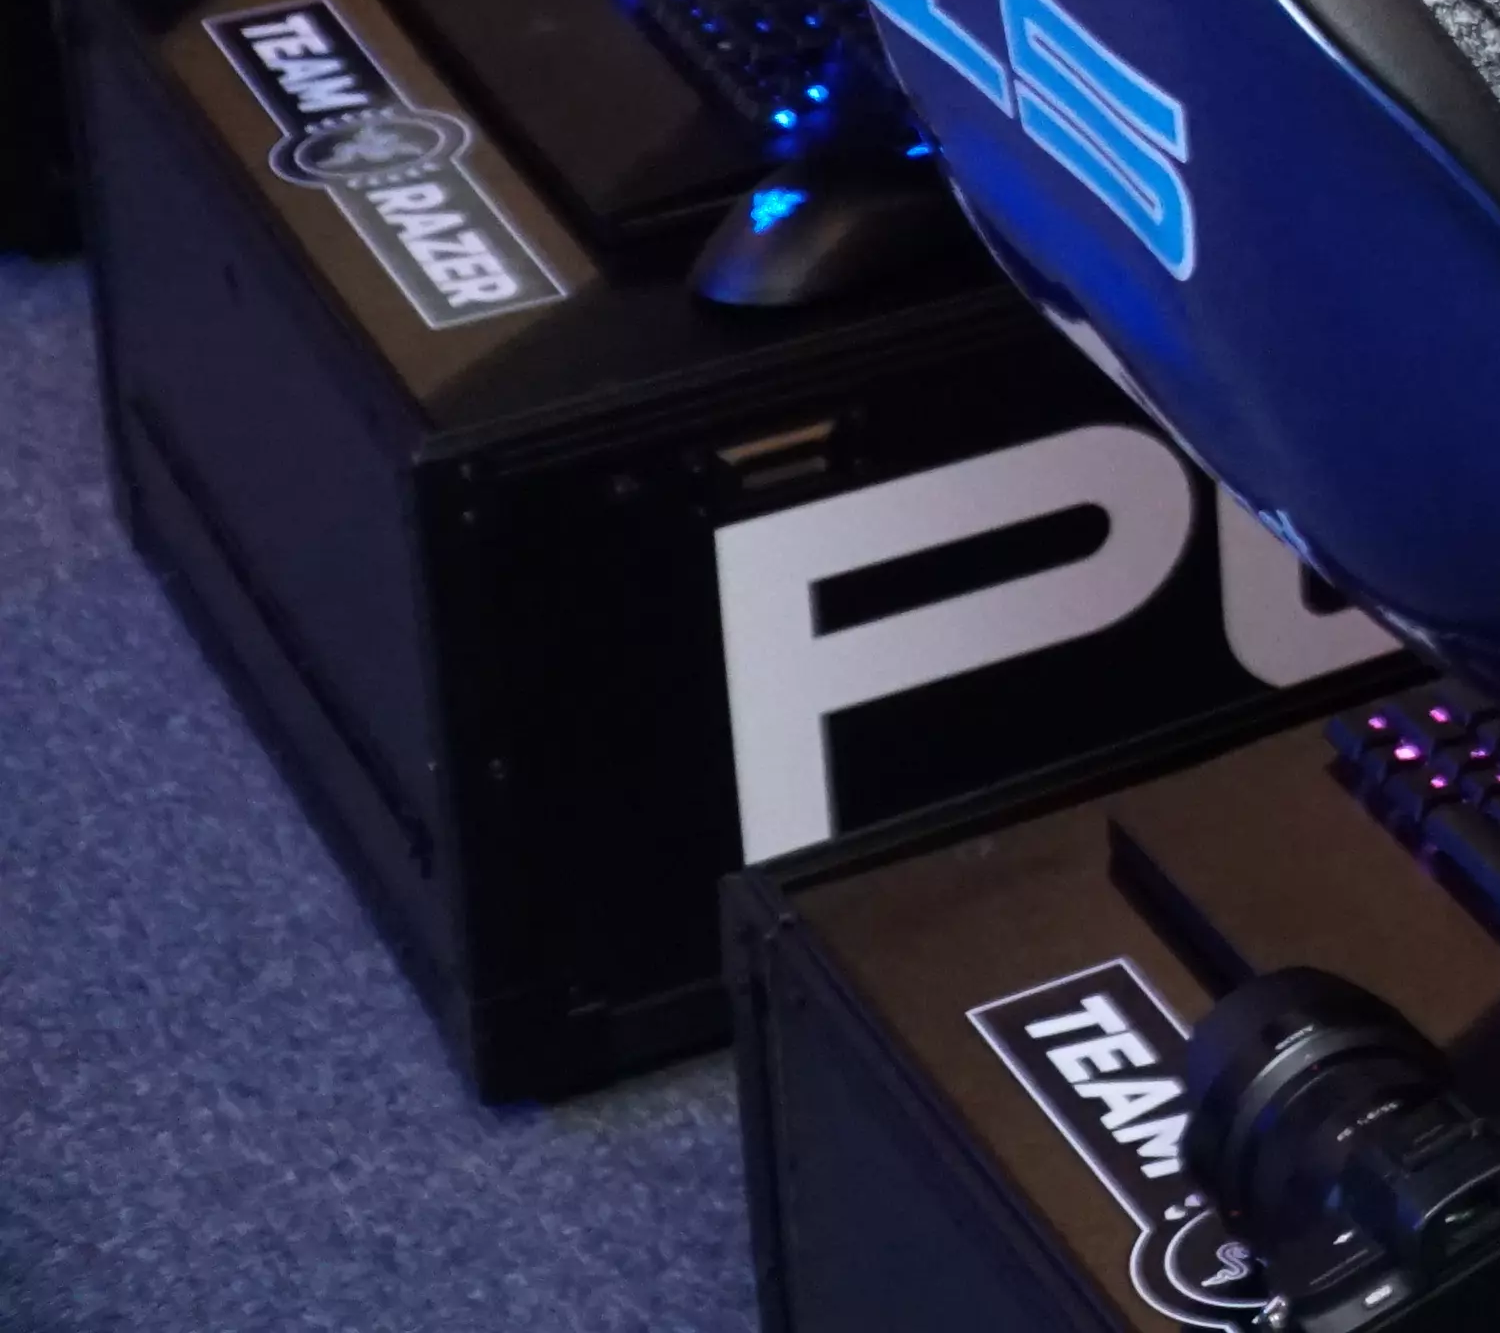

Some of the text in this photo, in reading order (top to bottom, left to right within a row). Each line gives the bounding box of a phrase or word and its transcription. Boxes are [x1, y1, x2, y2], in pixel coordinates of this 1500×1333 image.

[240, 13, 370, 114] TEAM
[366, 182, 518, 309] RAZER
[1025, 994, 1192, 1181] TEAM
